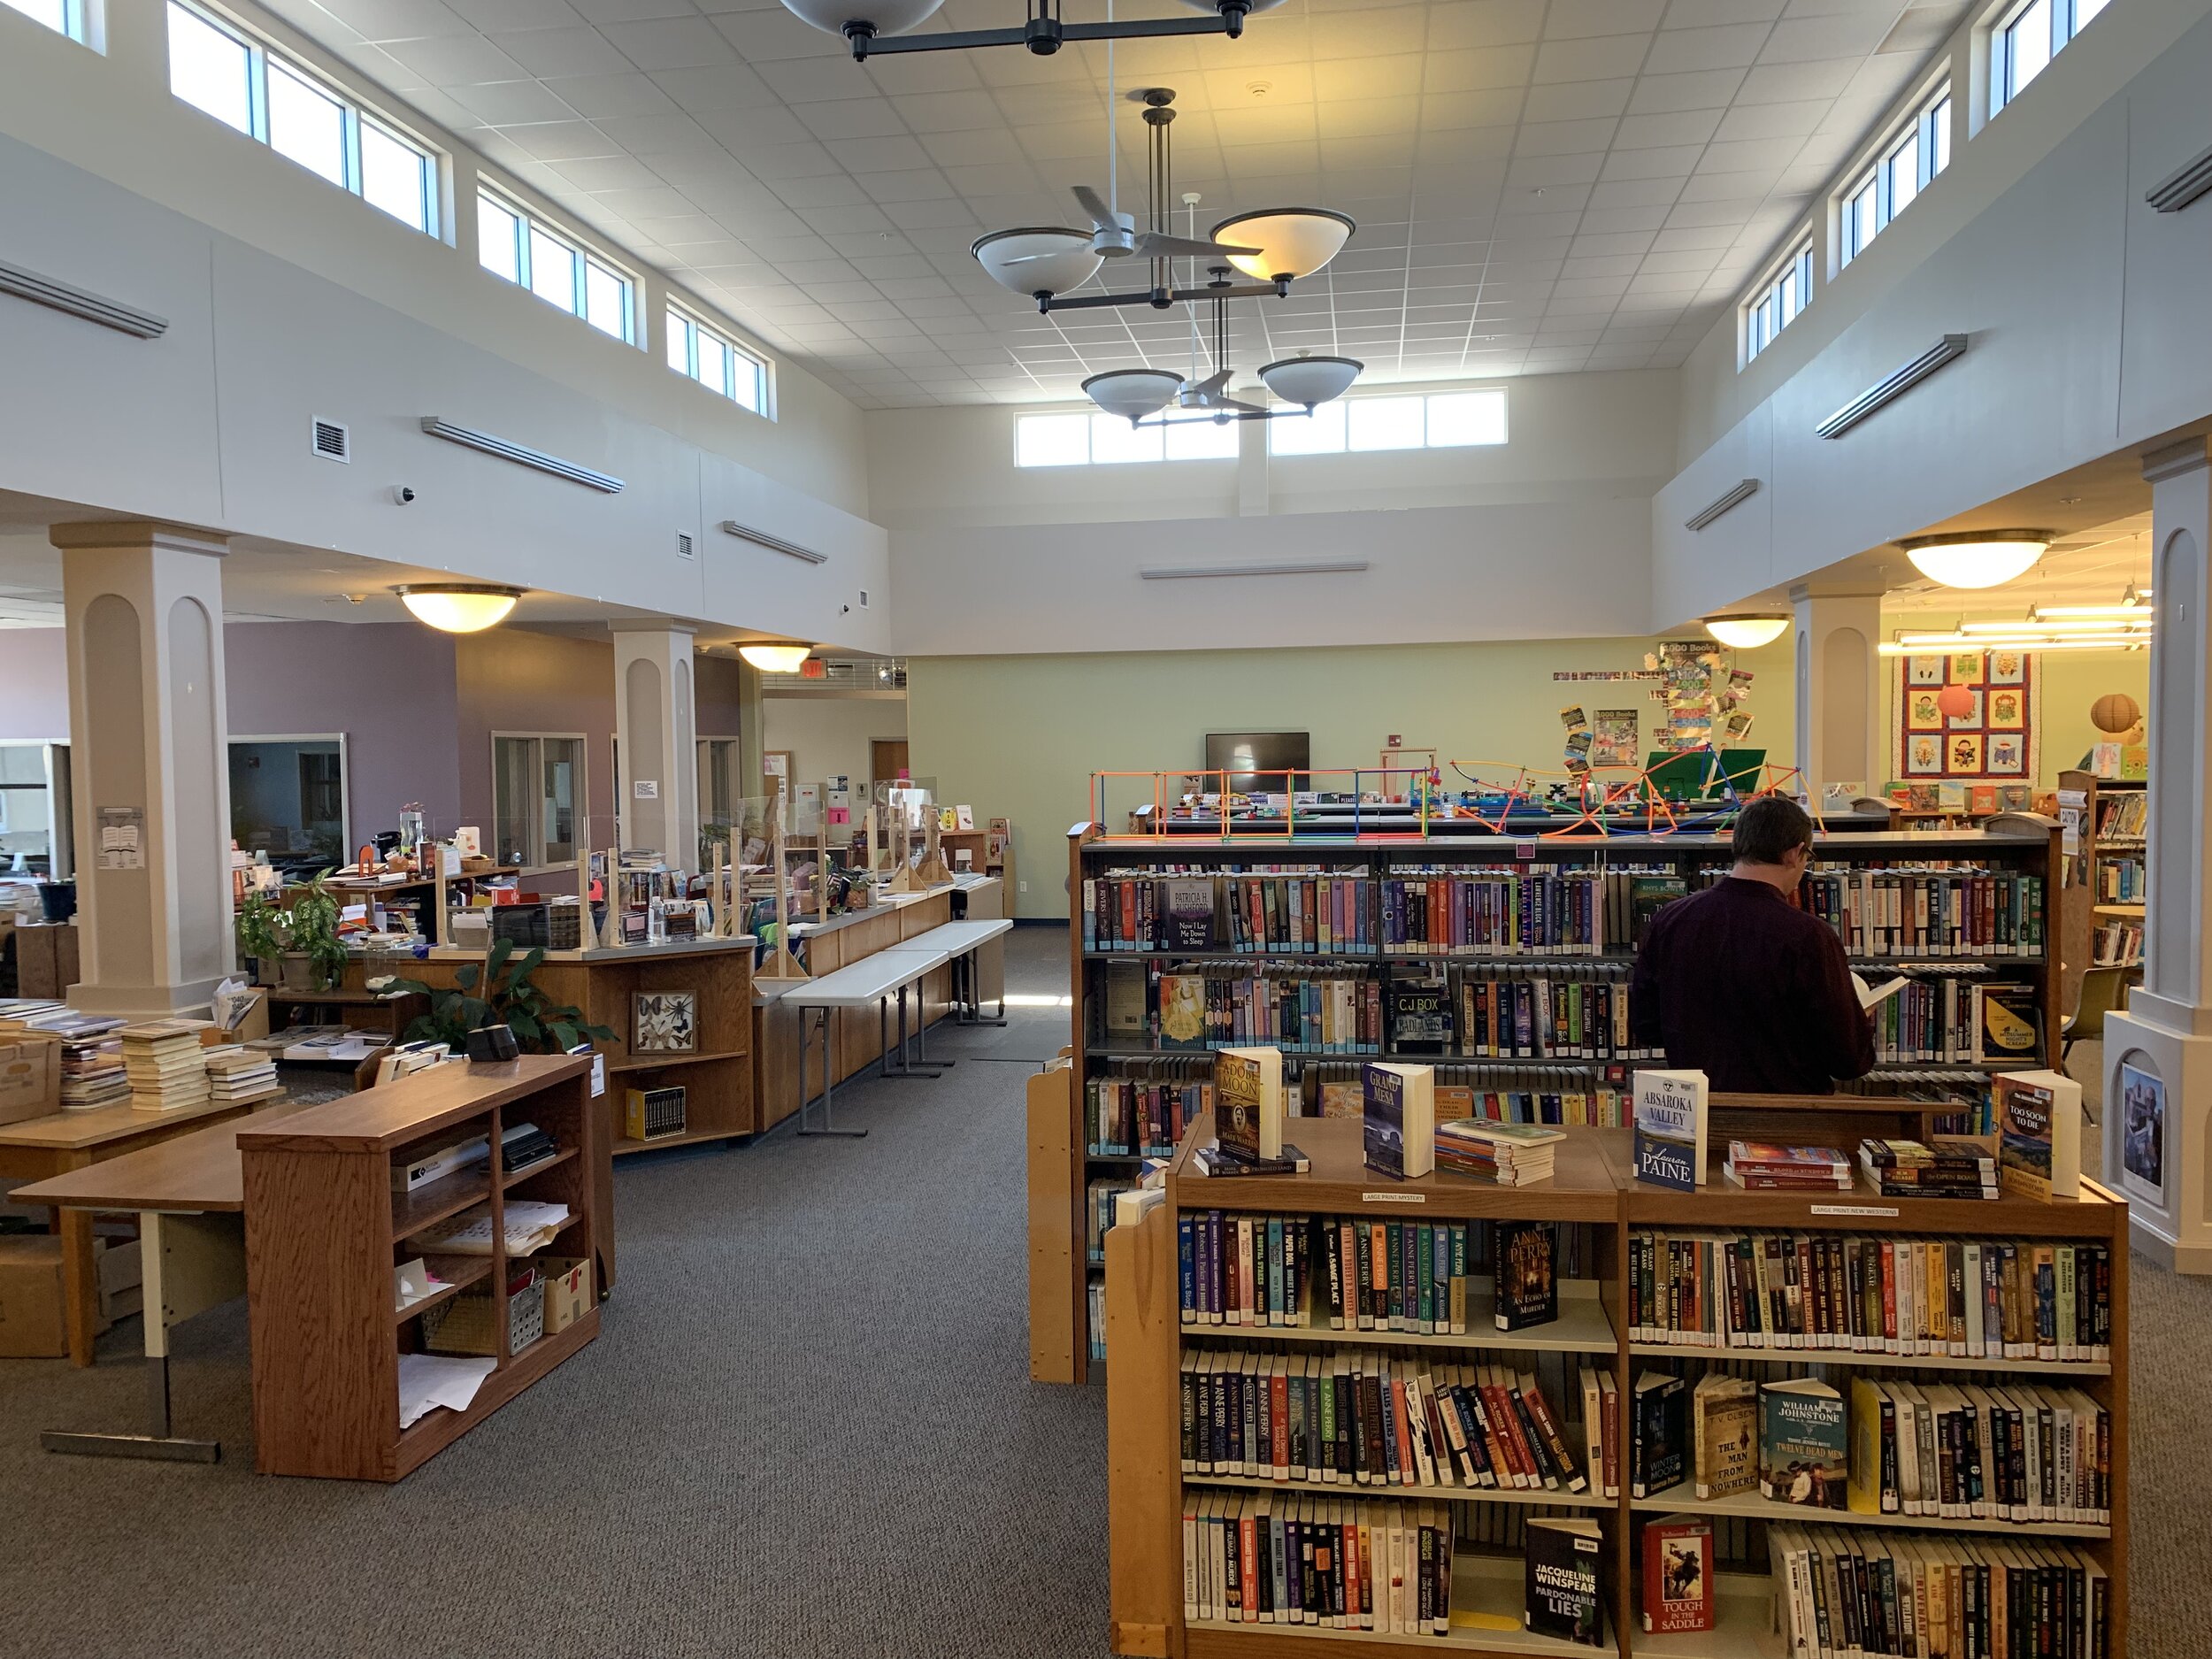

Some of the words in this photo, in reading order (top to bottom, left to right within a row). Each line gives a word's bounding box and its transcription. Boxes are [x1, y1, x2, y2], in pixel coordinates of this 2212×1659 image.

[804, 661, 822, 677] EXIT
[1175, 893, 1201, 903] PATRICIA
[1202, 893, 1208, 902] H.
[1176, 903, 1208, 913] RUSHFORD
[1417, 999, 1438, 1010] BOX
[1399, 1018, 1440, 1032] BADLANDS
[1223, 1063, 1256, 1081] ADOBE
[1223, 1077, 1257, 1095] MOON
[1370, 1071, 1398, 1092] GRAND
[1374, 1088, 1394, 1105] MESA
[1644, 1091, 1692, 1112] ABSAROKA
[1650, 1108, 1685, 1126] VALLEY
[2011, 1105, 2025, 1116] TOO
[2026, 1110, 2046, 1122] SOON
[2017, 1116, 2026, 1126] TO
[2028, 1119, 2039, 1130] DIE
[1237, 1135, 1257, 1148] WARREN
[1652, 1148, 1688, 1165] Lauran
[1642, 1152, 1690, 1182] PAINE
[1512, 1230, 1549, 1247] ANNE
[1511, 1241, 1552, 1262] PERRY
[1525, 1294, 1542, 1303] ECHO
[1520, 1304, 1545, 1314] MURDER
[1215, 1387, 1224, 1407] ANNE
[1383, 1388, 1391, 1407] ELLIS
[1783, 1401, 1821, 1412] WILLIAM
[1216, 1408, 1225, 1427] PERRY
[1385, 1410, 1393, 1437] PETERS
[1464, 1411, 1474, 1430] ROKER
[1495, 1411, 1506, 1429] ROKER
[1727, 1410, 1754, 1421] OLSEN
[1779, 1408, 1839, 1423] JOHNSTONE
[1718, 1442, 1735, 1453] THE
[1776, 1442, 1804, 1454] TWELVE
[1806, 1446, 1826, 1457] DEAD
[1828, 1449, 1843, 1459] MEN
[1650, 1454, 1680, 1470] WINTER
[1728, 1453, 1747, 1463] MAN
[1650, 1466, 1675, 1480] MOON
[1718, 1466, 1744, 1479] FROM
[1711, 1476, 1754, 1493] NOWHERE
[1536, 1564, 1595, 1584] JACQUELINE
[1536, 1573, 1596, 1594] WINSPEAR
[1536, 1587, 1596, 1607] PARDONABLE
[1549, 1598, 1582, 1618] LIES
[1663, 1601, 1703, 1612] TOUGH
[1903, 1596, 1913, 1634] REVELATION
[1916, 1580, 1926, 1637] REVENANT
[1662, 1618, 1704, 1630] SADDLE
